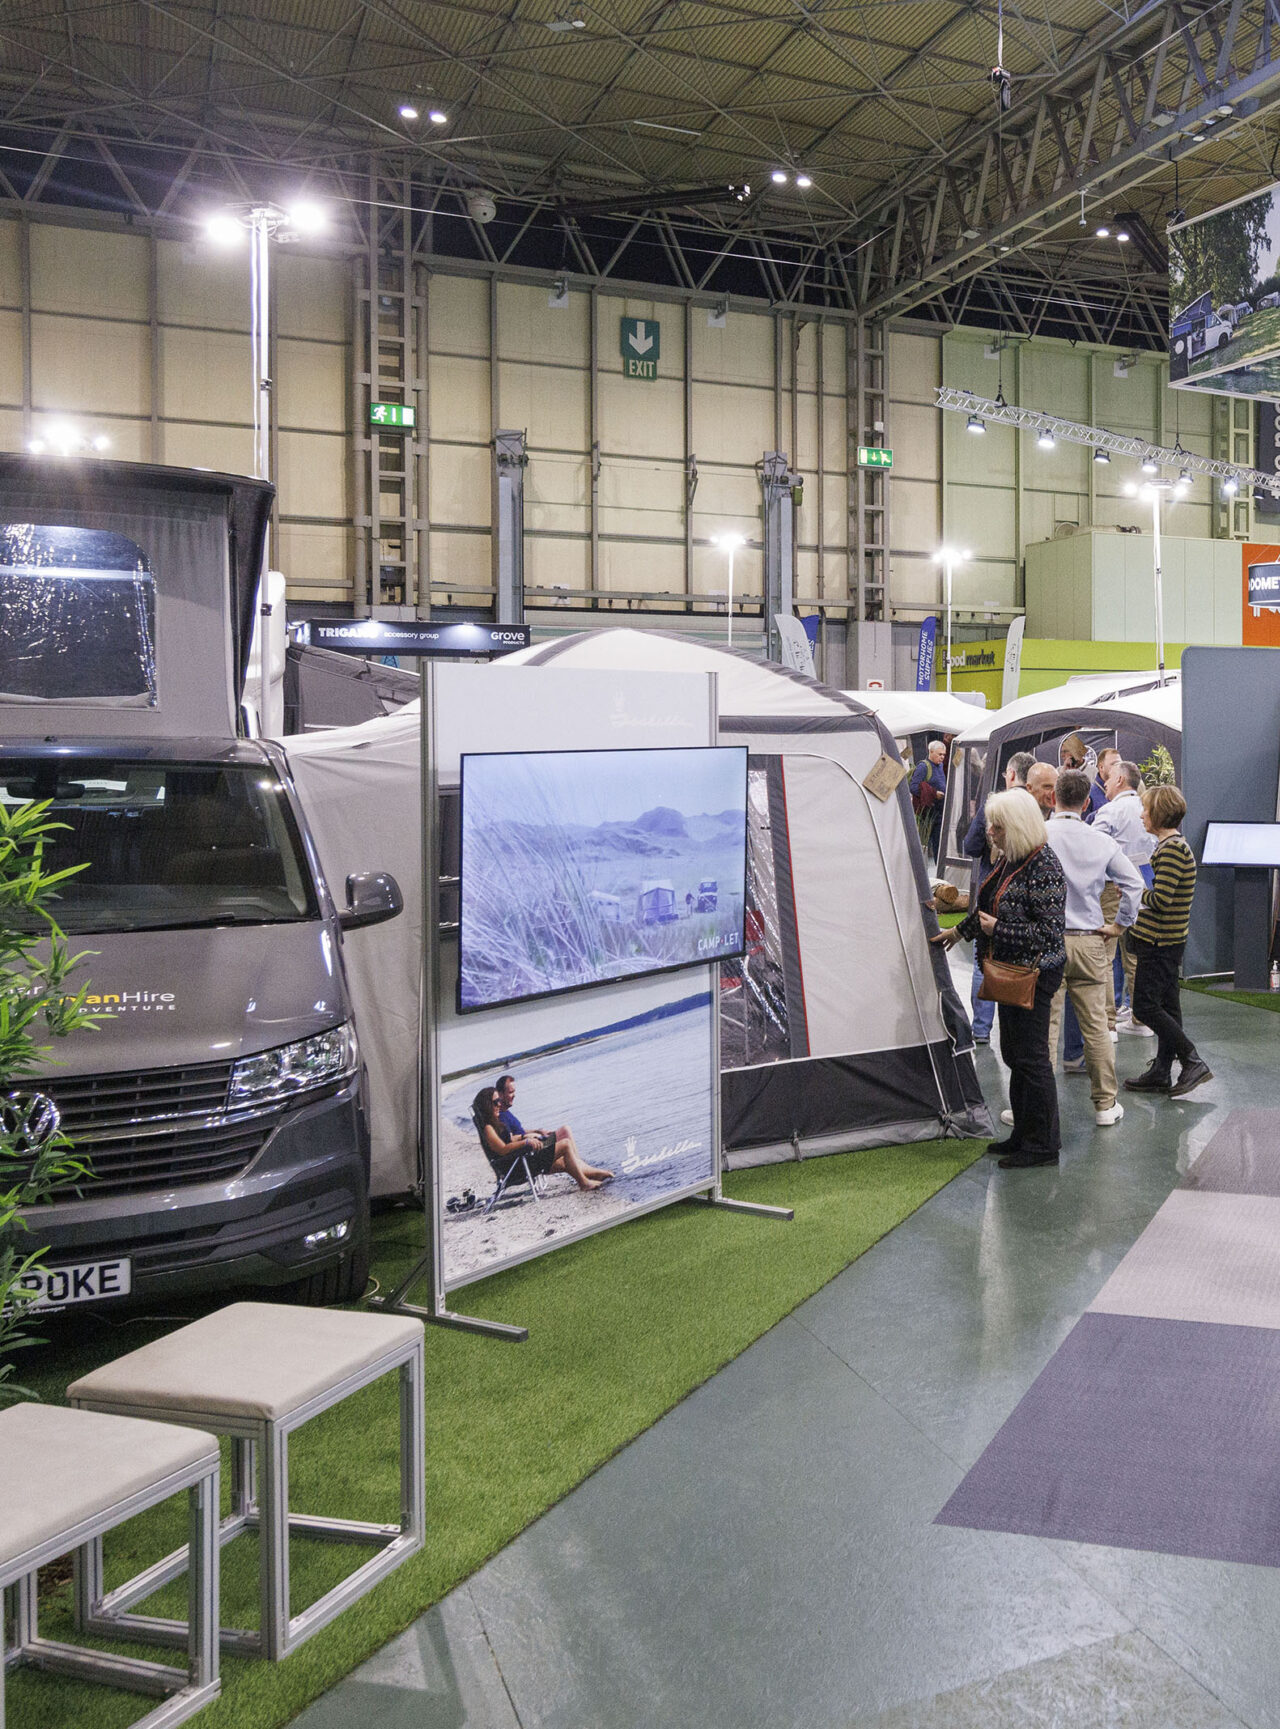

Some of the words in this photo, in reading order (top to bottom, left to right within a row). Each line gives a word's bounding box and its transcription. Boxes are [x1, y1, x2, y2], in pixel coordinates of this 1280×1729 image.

[629, 359, 655, 377] EXIT
[318, 627, 379, 639] TRIGA
[383, 631, 418, 639] accessory
[490, 631, 525, 641] Grove
[918, 630, 928, 686] MOTORHOME
[924, 639, 934, 681] SUPPLIES
[949, 649, 966, 667] ood
[78, 1004, 177, 1014] DVENTURE
